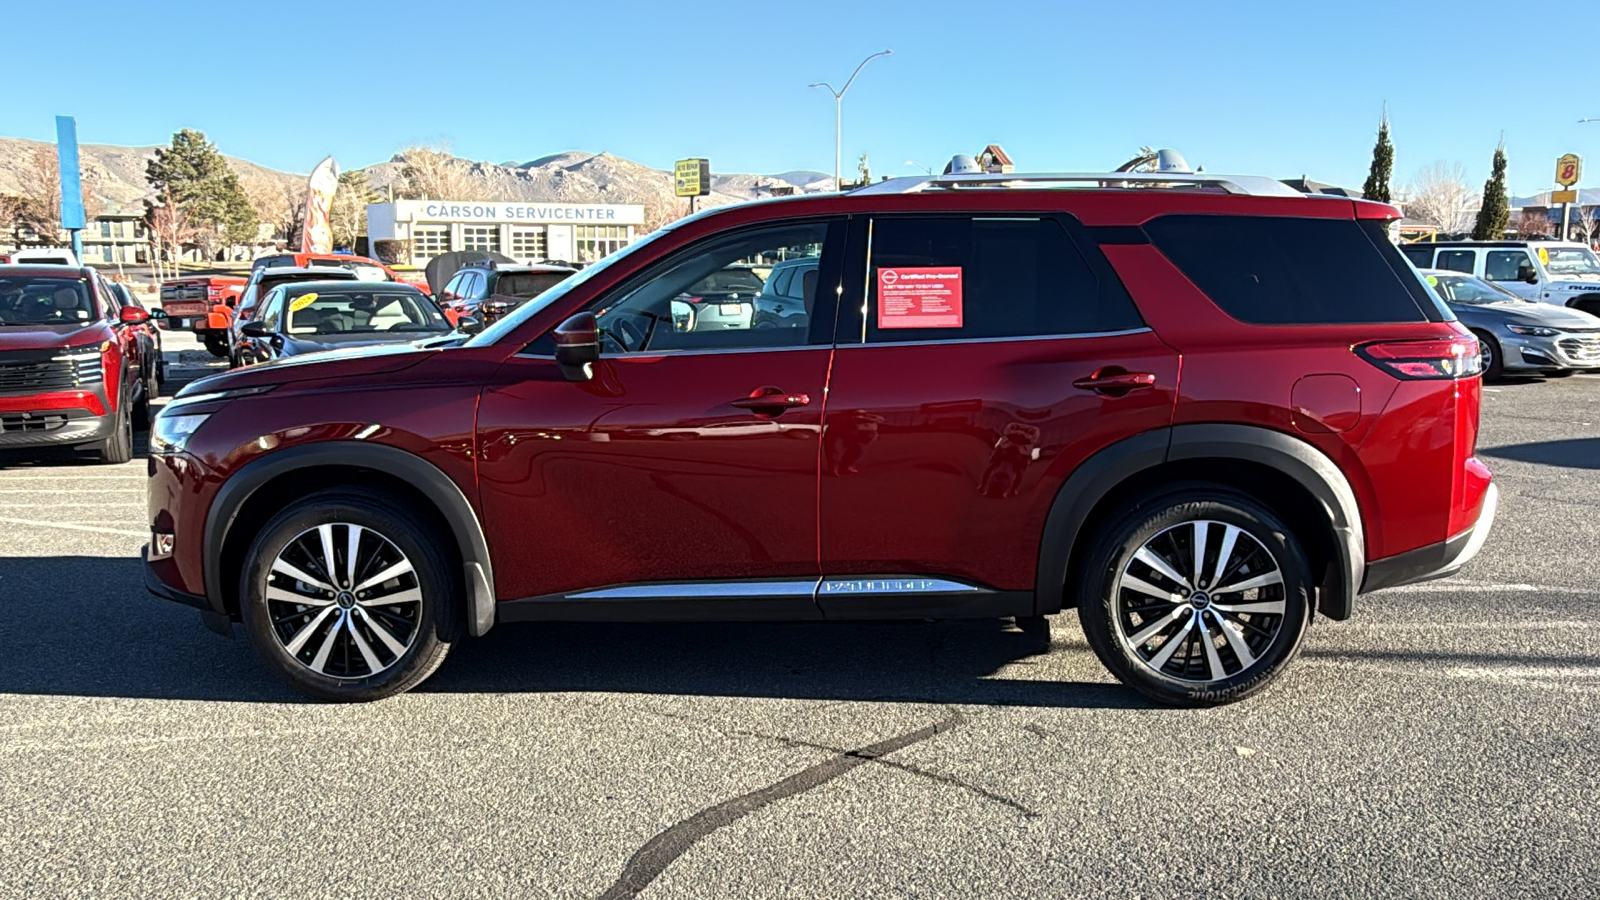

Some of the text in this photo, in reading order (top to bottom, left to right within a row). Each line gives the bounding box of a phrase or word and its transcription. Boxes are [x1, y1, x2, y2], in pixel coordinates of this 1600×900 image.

[1561, 164, 1575, 179] 8
[426, 204, 615, 220] CARSON SERVICENTER
